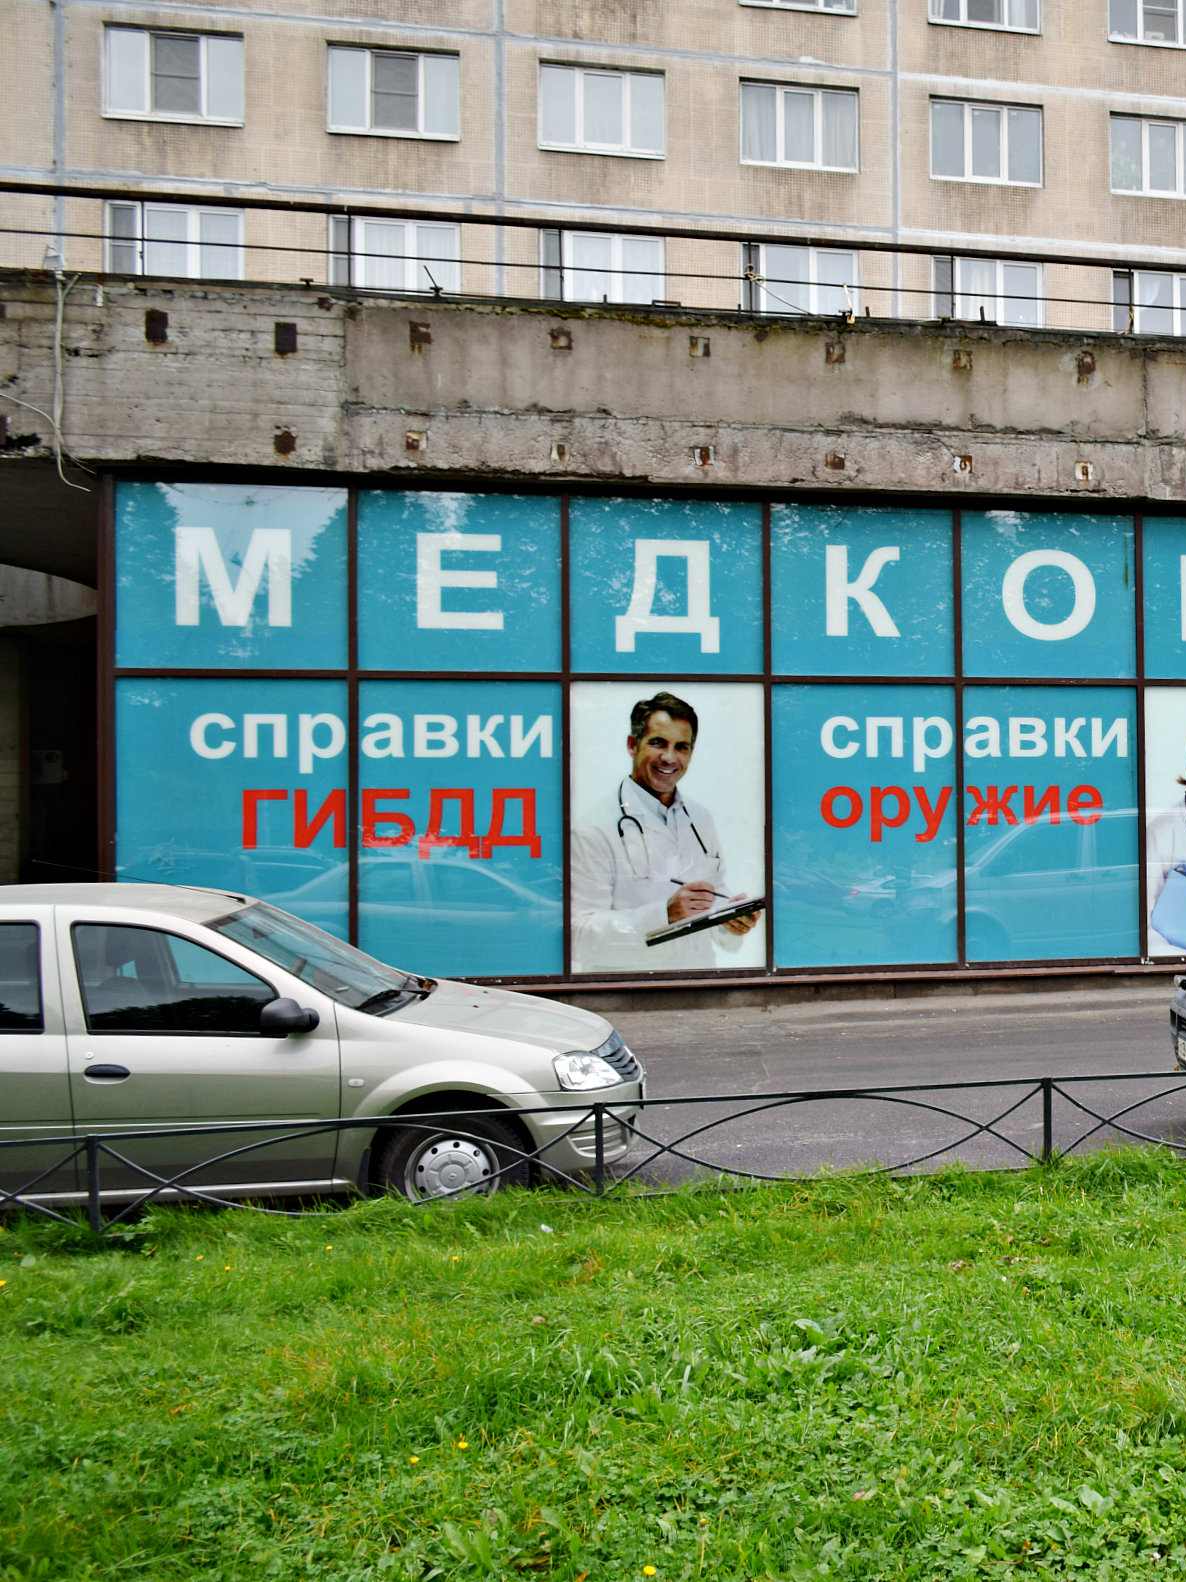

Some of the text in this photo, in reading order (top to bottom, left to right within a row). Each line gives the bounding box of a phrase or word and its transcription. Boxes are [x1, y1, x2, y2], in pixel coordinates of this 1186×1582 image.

[189, 713, 553, 773] справки
[820, 716, 1128, 772] справки
[242, 788, 542, 859] ГИБДД
[820, 784, 1103, 842] оружие
